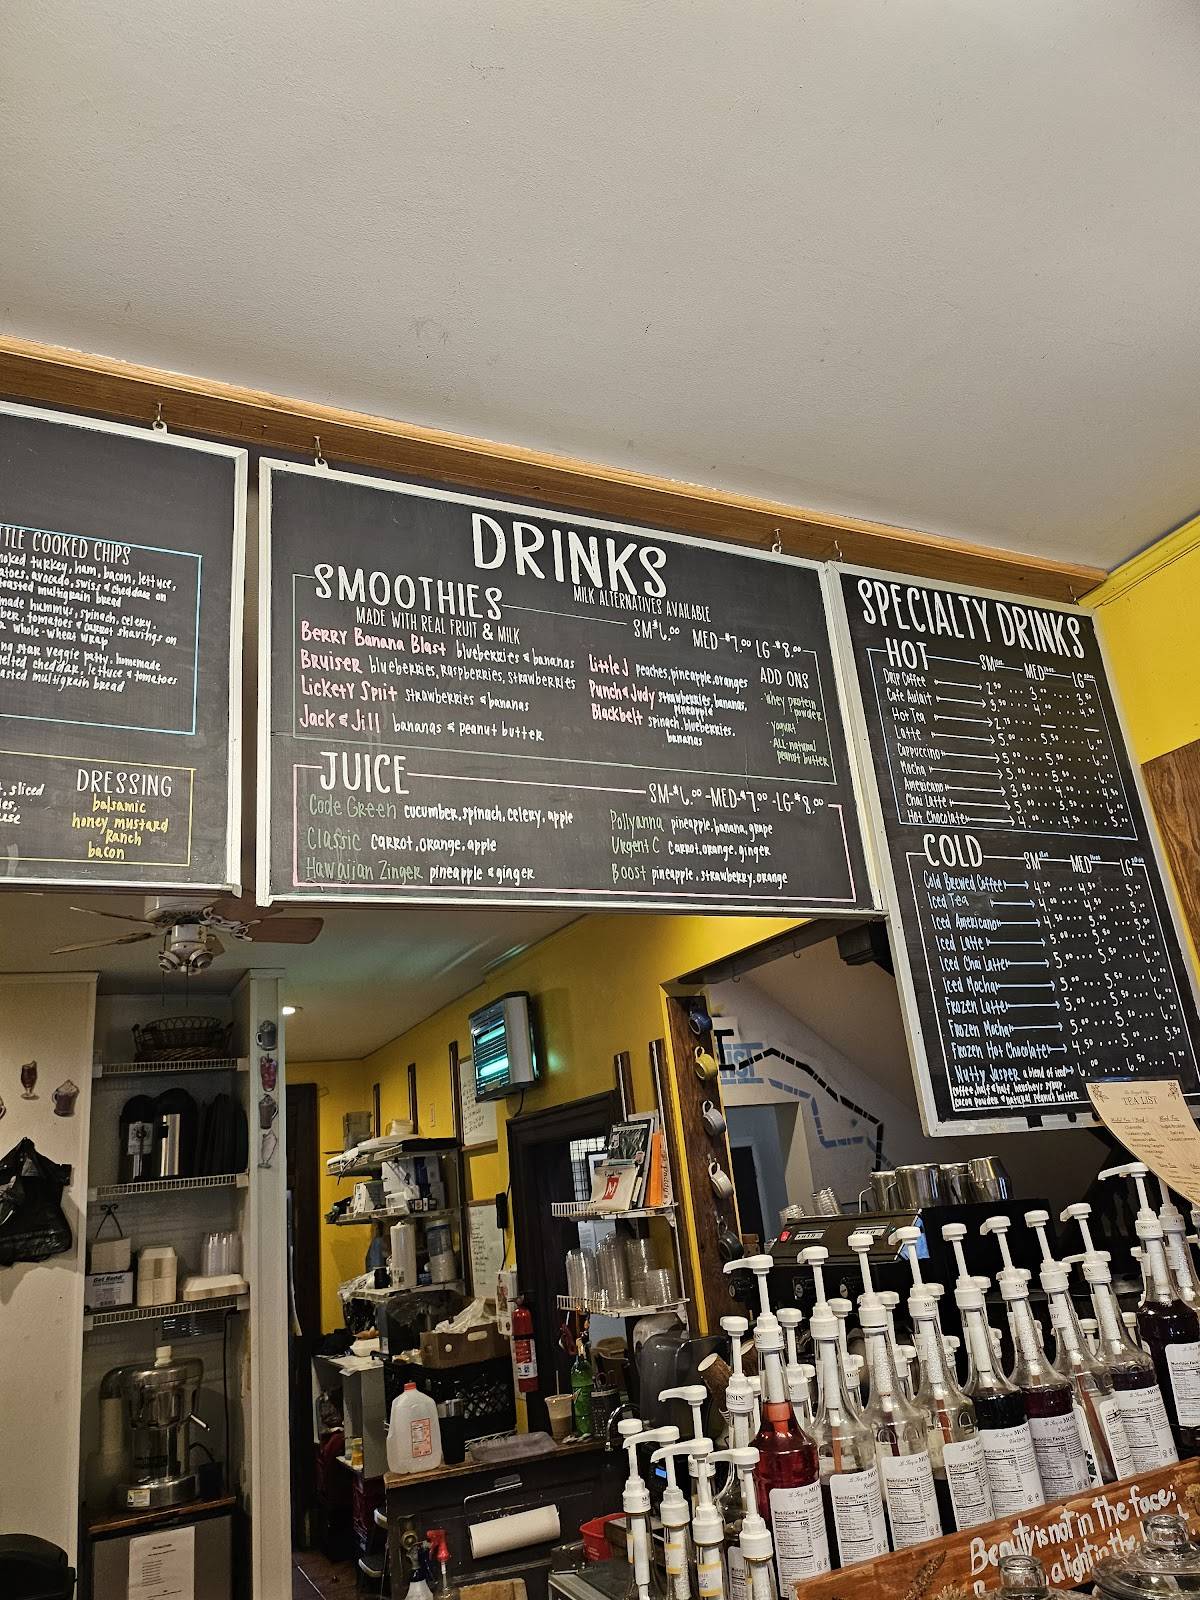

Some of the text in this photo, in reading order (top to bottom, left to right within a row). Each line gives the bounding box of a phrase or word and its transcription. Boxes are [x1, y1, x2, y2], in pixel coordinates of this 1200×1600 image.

[32, 531, 131, 565] COOKED CHIPS
[471, 512, 667, 598] DRINKS
[75, 560, 101, 578] ham,
[103, 566, 136, 585] bacon,
[138, 571, 177, 592] lettuce,
[37, 585, 122, 608] multigrain bread
[75, 578, 150, 600] swiss cheddar
[314, 563, 502, 621] SMOOTHIES
[573, 585, 712, 623] MILK ALTERNATIVES AVAILABLE
[27, 611, 163, 646] tomatoes carrot shavings
[356, 606, 520, 645] MADE WITH REAL FRUIT & MILK
[857, 578, 1085, 659] SPECIALTY DRINKS
[13, 622, 108, 651] whole-wheat wrap
[301, 620, 575, 669] Berry Banana Blast blueberries bananas
[16, 643, 161, 671] star veggie homemade
[588, 653, 629, 677] Little J
[885, 637, 929, 671] HOT
[87, 664, 178, 685] lettuce tomatoes
[300, 648, 576, 689] Bruiser strawberries
[760, 666, 809, 689] ADD ONS
[882, 667, 927, 688] Drip Coffee
[32, 671, 125, 693] multigrain bread
[404, 687, 474, 705] strawberries
[487, 691, 529, 711] bananas
[588, 679, 656, 710] Punch Judy
[788, 696, 816, 712] protein
[886, 687, 904, 702] Cafe
[299, 703, 544, 741] Jack Jill bananas peanut butter
[591, 703, 643, 726] Blackbelt
[673, 704, 713, 721] pineapple
[794, 709, 822, 723] powder
[891, 707, 910, 722] Hot
[910, 708, 927, 725] Tea
[665, 728, 702, 746] bananas
[894, 724, 922, 741] Latte
[803, 752, 830, 767] butter
[900, 760, 927, 777] Mocha
[76, 768, 173, 797] DRESSING
[320, 751, 410, 795] JUICE
[904, 776, 944, 793] Americano
[9, 781, 45, 796] sliced
[92, 793, 147, 814] balsamic
[309, 793, 573, 829] Code Green apple
[905, 793, 947, 809] Chai Latte
[71, 812, 169, 834] honey mustard
[610, 808, 773, 842] Pollyanna grape
[907, 809, 967, 825] Hot Chocolate
[105, 829, 142, 846] Ranch
[307, 826, 497, 855] Classic apple
[87, 840, 125, 860] bacon
[611, 836, 771, 863] Urgent C ginger
[923, 833, 984, 868] COLD
[306, 857, 535, 886] Hawaiian Zinger pineapple ginger
[611, 863, 788, 889] Boost orange
[923, 869, 1004, 893] Cold Brewed Coffee
[927, 891, 969, 909] Iced Tea
[931, 913, 998, 932] Iced Americano
[935, 934, 984, 952] Iced Latte
[939, 954, 1007, 972] Iced Chai Latte
[942, 975, 998, 996] Iced Mocha
[944, 997, 1007, 1015] Frozen Latte
[948, 1019, 1011, 1039] Frozen Mocha
[950, 1041, 1050, 1060] Frozen Hot Chocolate
[954, 1064, 986, 1083] Nutty
[989, 1063, 1021, 1082] Jasper
[1121, 1095, 1159, 1106] TEA LIST
[1034, 1525, 1049, 1549] is
[1048, 1508, 1075, 1545] not
[1075, 1512, 1095, 1537] in
[1128, 1484, 1177, 1518] face;
[1051, 1561, 1066, 1585] a
[1061, 1538, 1094, 1583] light
[1094, 1544, 1110, 1561] in
